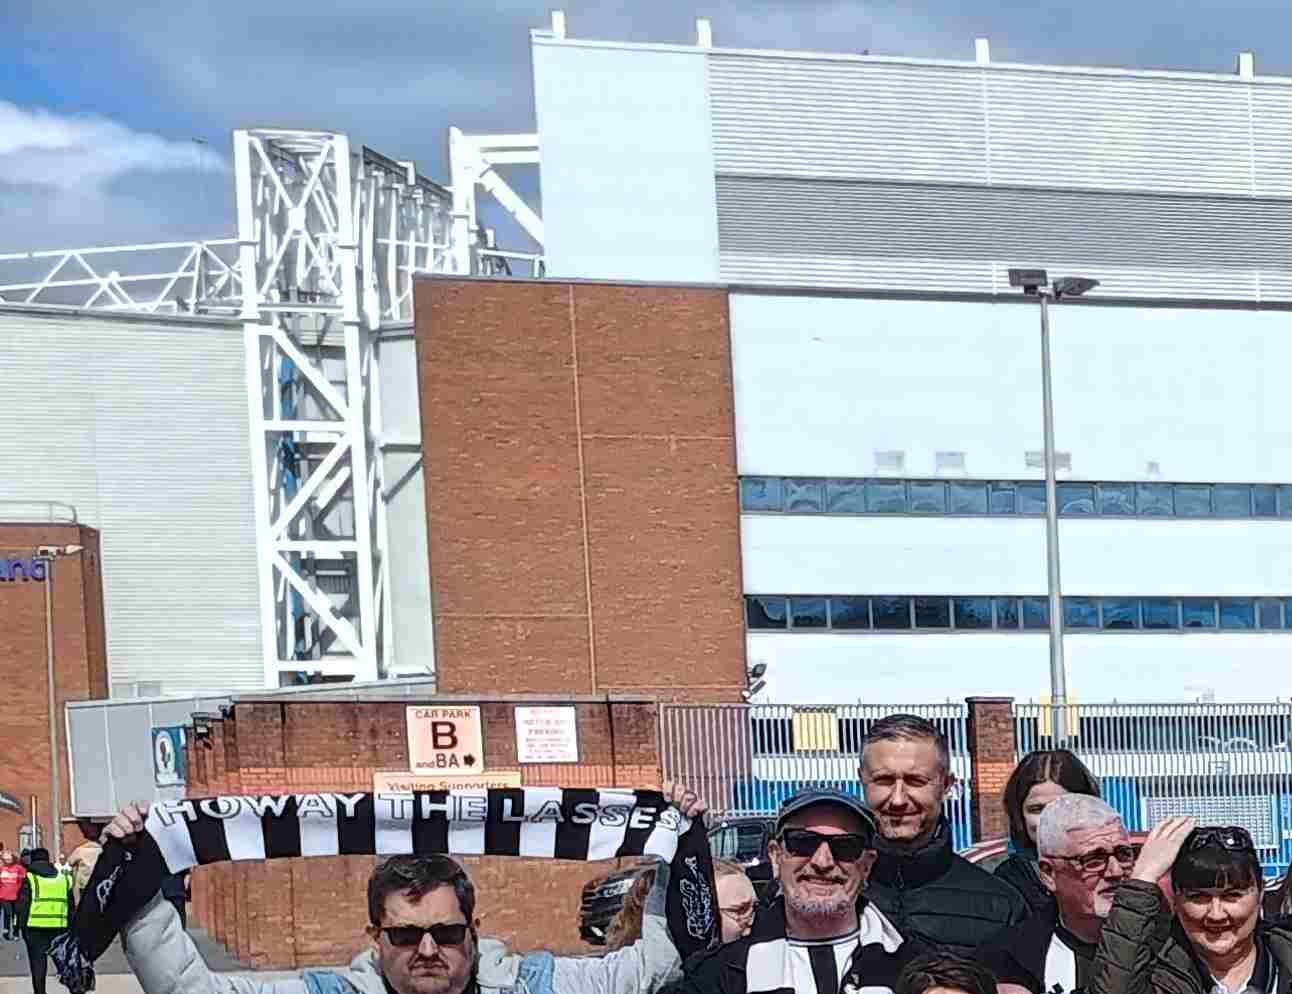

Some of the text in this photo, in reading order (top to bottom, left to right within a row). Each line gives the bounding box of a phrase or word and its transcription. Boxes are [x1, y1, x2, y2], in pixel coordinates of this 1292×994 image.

[415, 709, 472, 719] CAR PARK
[430, 721, 459, 750] B
[415, 753, 460, 769] and BA
[156, 792, 682, 832] HOWAY THE LASSES
